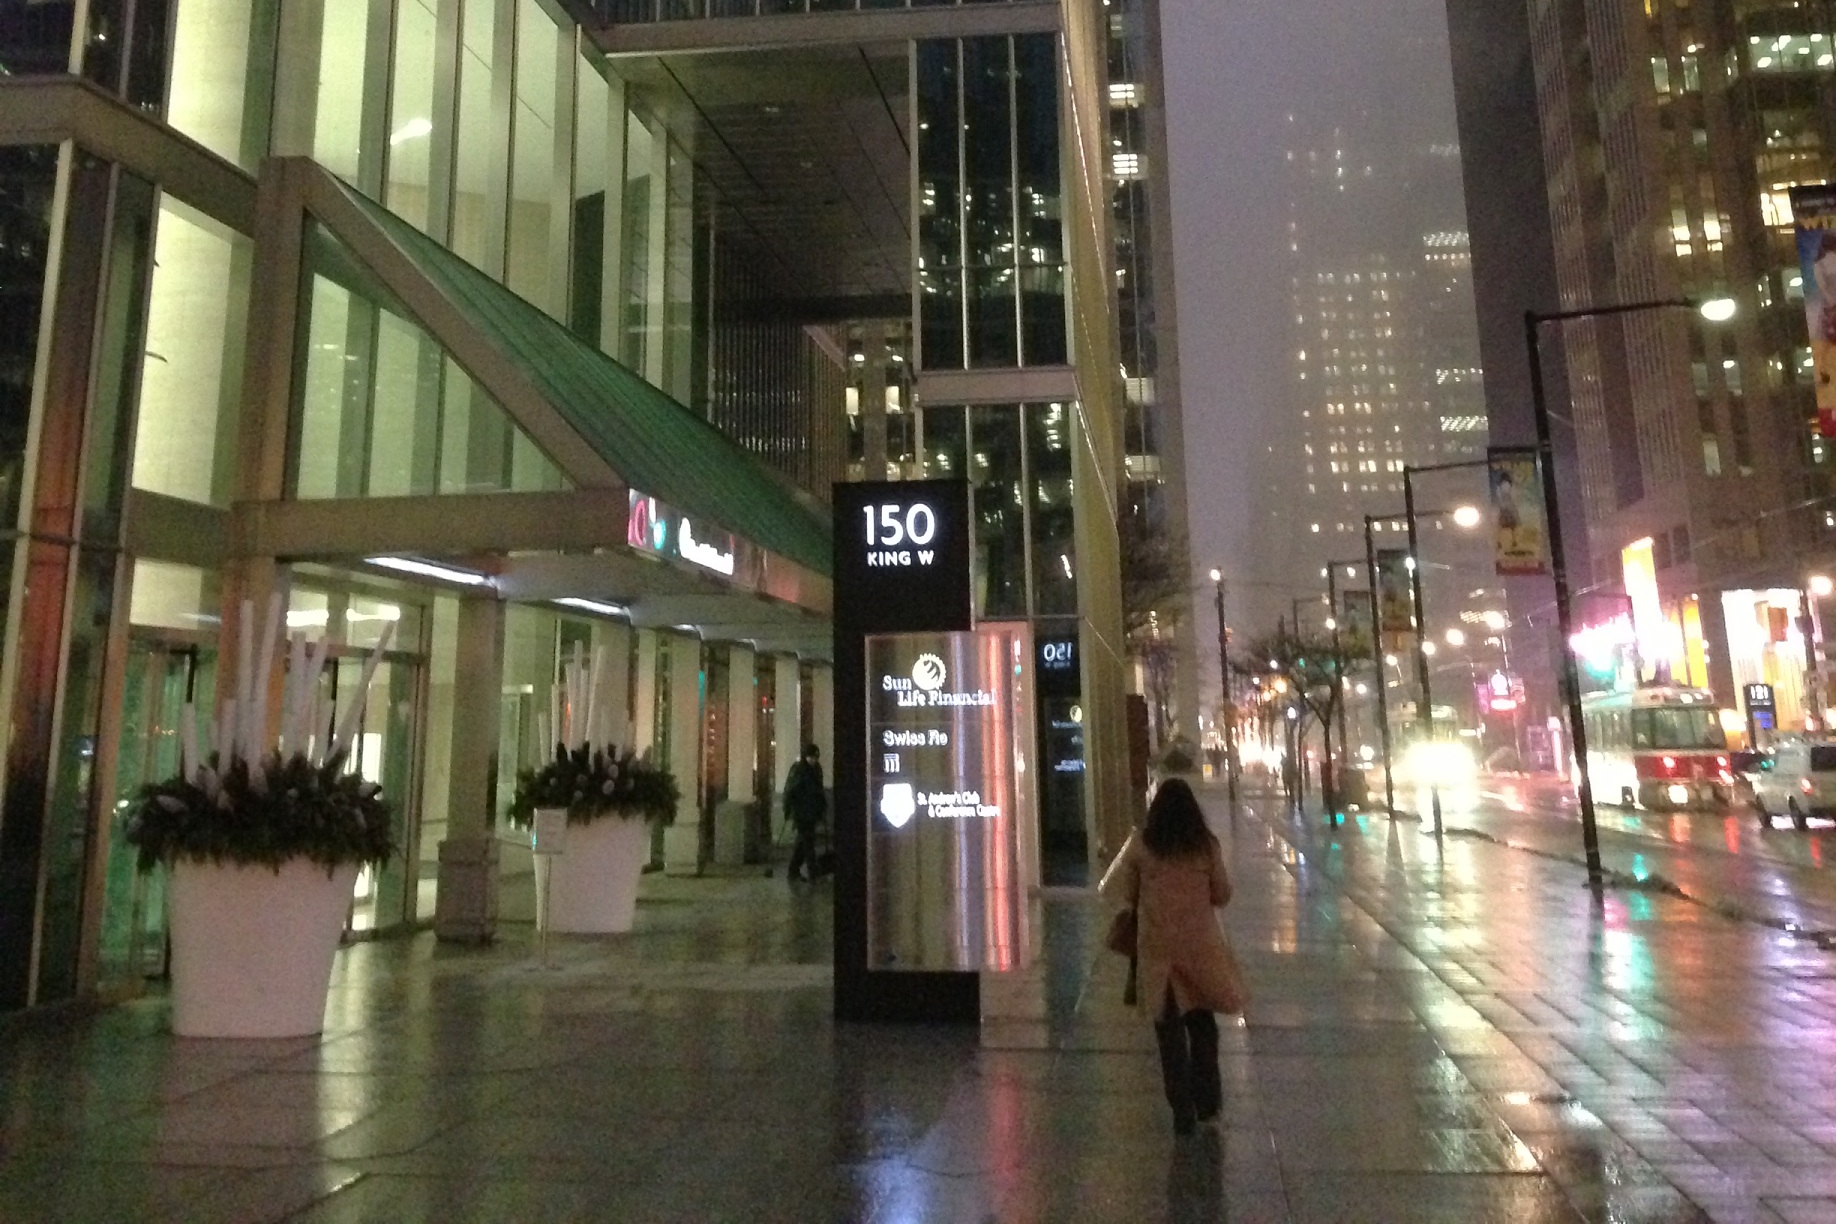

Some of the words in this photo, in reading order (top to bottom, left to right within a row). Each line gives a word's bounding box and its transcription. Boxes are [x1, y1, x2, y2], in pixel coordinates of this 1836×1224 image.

[863, 503, 935, 546] 150
[867, 550, 911, 567] KING
[917, 549, 934, 565] W
[882, 674, 912, 691] Sun
[897, 690, 926, 707] Life
[927, 688, 998, 707] Financial
[882, 729, 926, 746] Swiss
